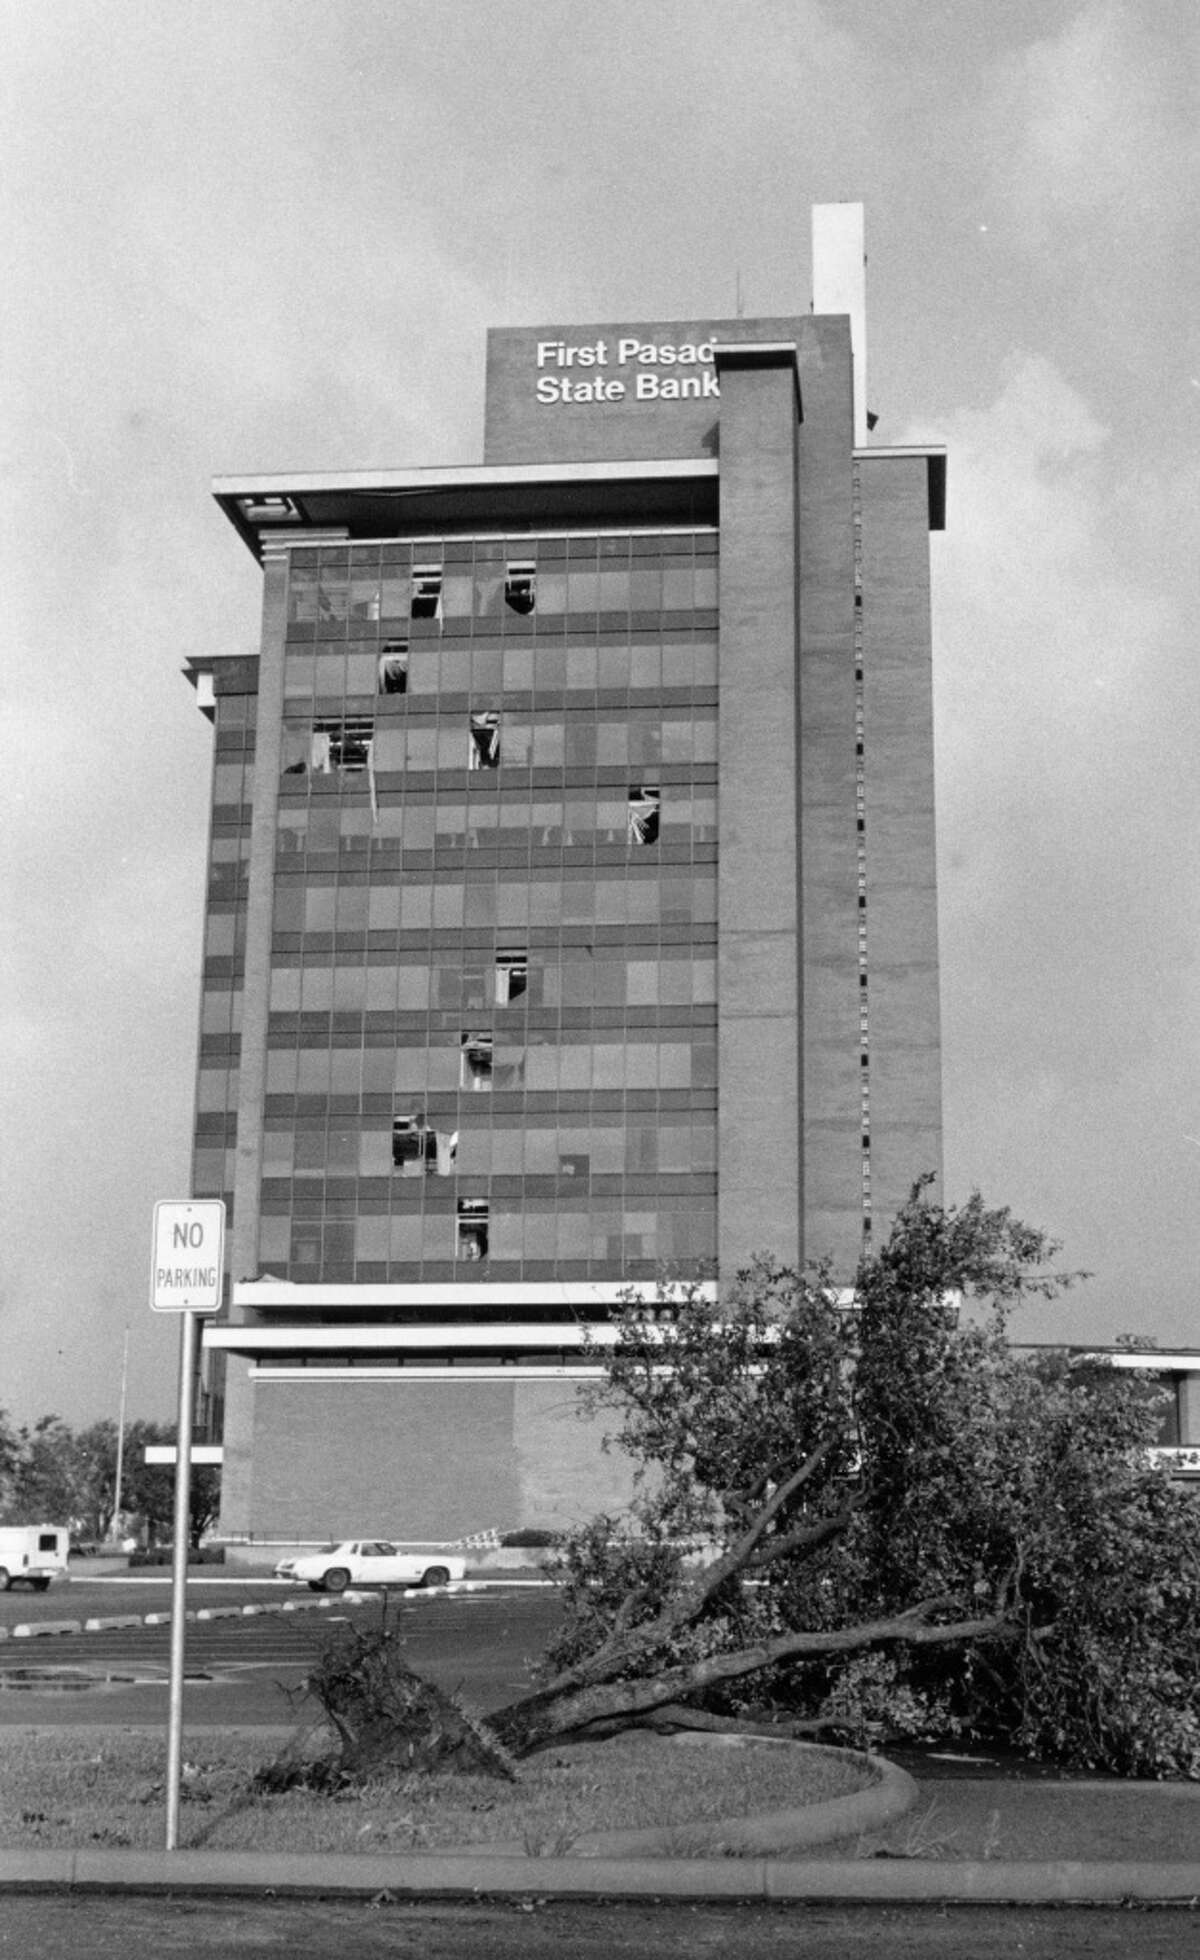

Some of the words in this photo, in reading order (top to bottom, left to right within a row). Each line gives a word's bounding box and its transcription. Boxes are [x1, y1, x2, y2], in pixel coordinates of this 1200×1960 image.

[537, 340, 608, 367] First
[536, 376, 625, 403] State
[636, 371, 720, 399] Bank
[173, 1222, 204, 1248] NO
[157, 1267, 216, 1288] PARKING
